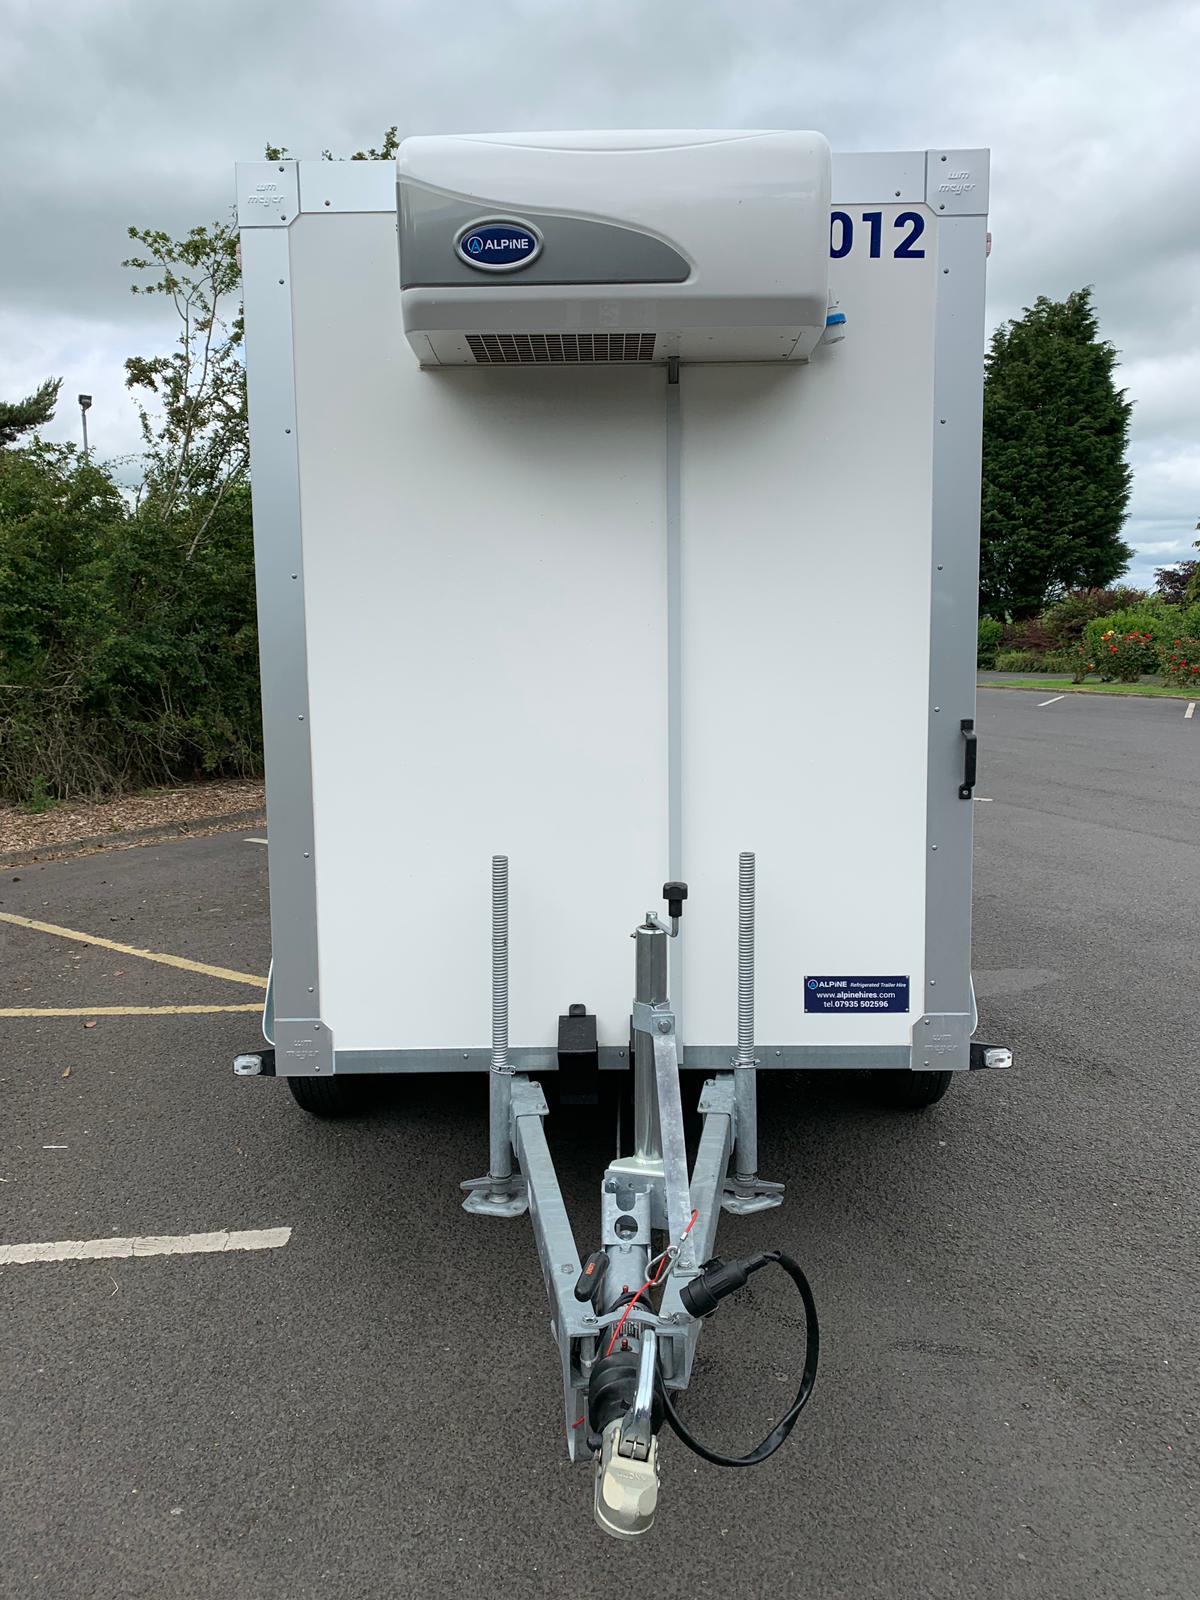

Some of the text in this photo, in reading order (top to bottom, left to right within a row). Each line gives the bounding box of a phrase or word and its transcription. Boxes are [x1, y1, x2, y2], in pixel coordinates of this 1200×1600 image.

[829, 211, 925, 259] 012
[816, 991, 896, 1000] www.alpinehires.com
[823, 1000, 889, 1008] tel.07935 502596
